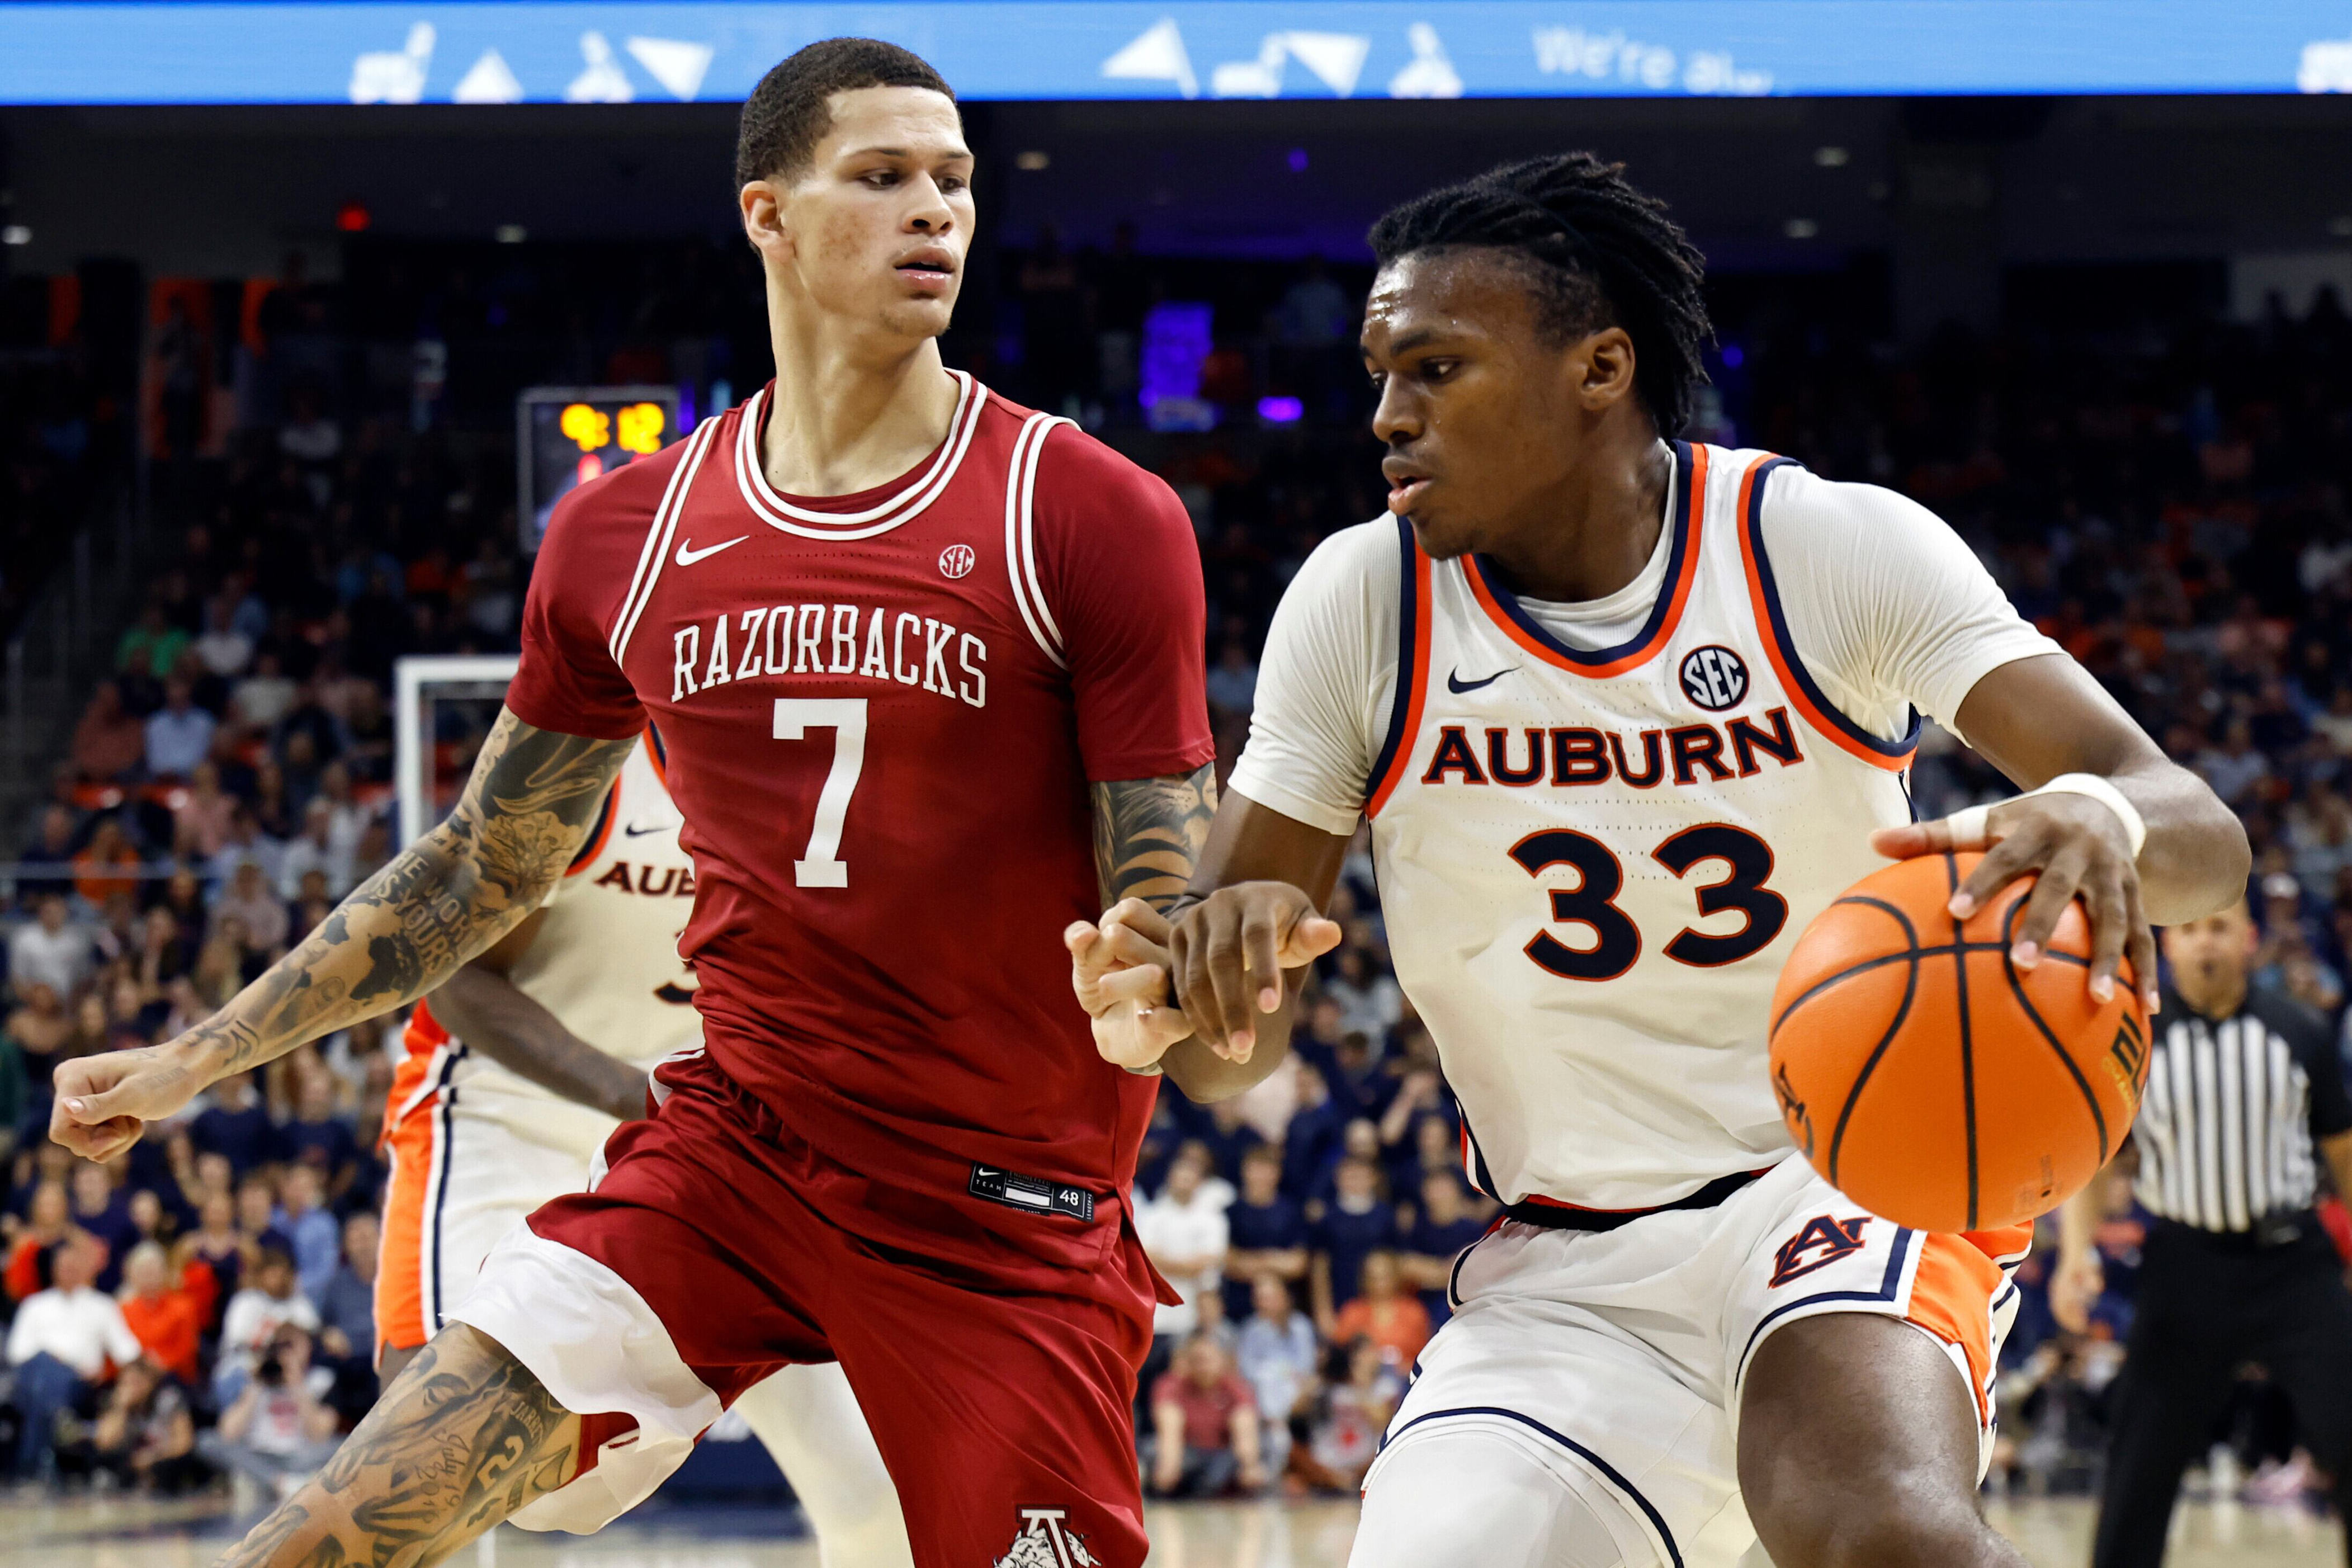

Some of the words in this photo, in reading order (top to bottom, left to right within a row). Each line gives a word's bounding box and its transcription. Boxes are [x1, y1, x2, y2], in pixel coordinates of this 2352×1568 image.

[1532, 27, 1675, 89] We're
[941, 546, 972, 576] SEC
[672, 603, 987, 708] RAZORBACKS
[1684, 649, 1744, 707] SEC
[1421, 706, 1804, 789] AUBURN
[772, 698, 868, 888] 7
[1507, 822, 1789, 981] 33
[395, 887, 455, 976] YOURS
[976, 1179, 1002, 1191] TEAM
[1059, 1189, 1079, 1206] 48
[432, 1427, 470, 1475] July
[476, 1435, 525, 1491] 2
[444, 1484, 461, 1507] 19
